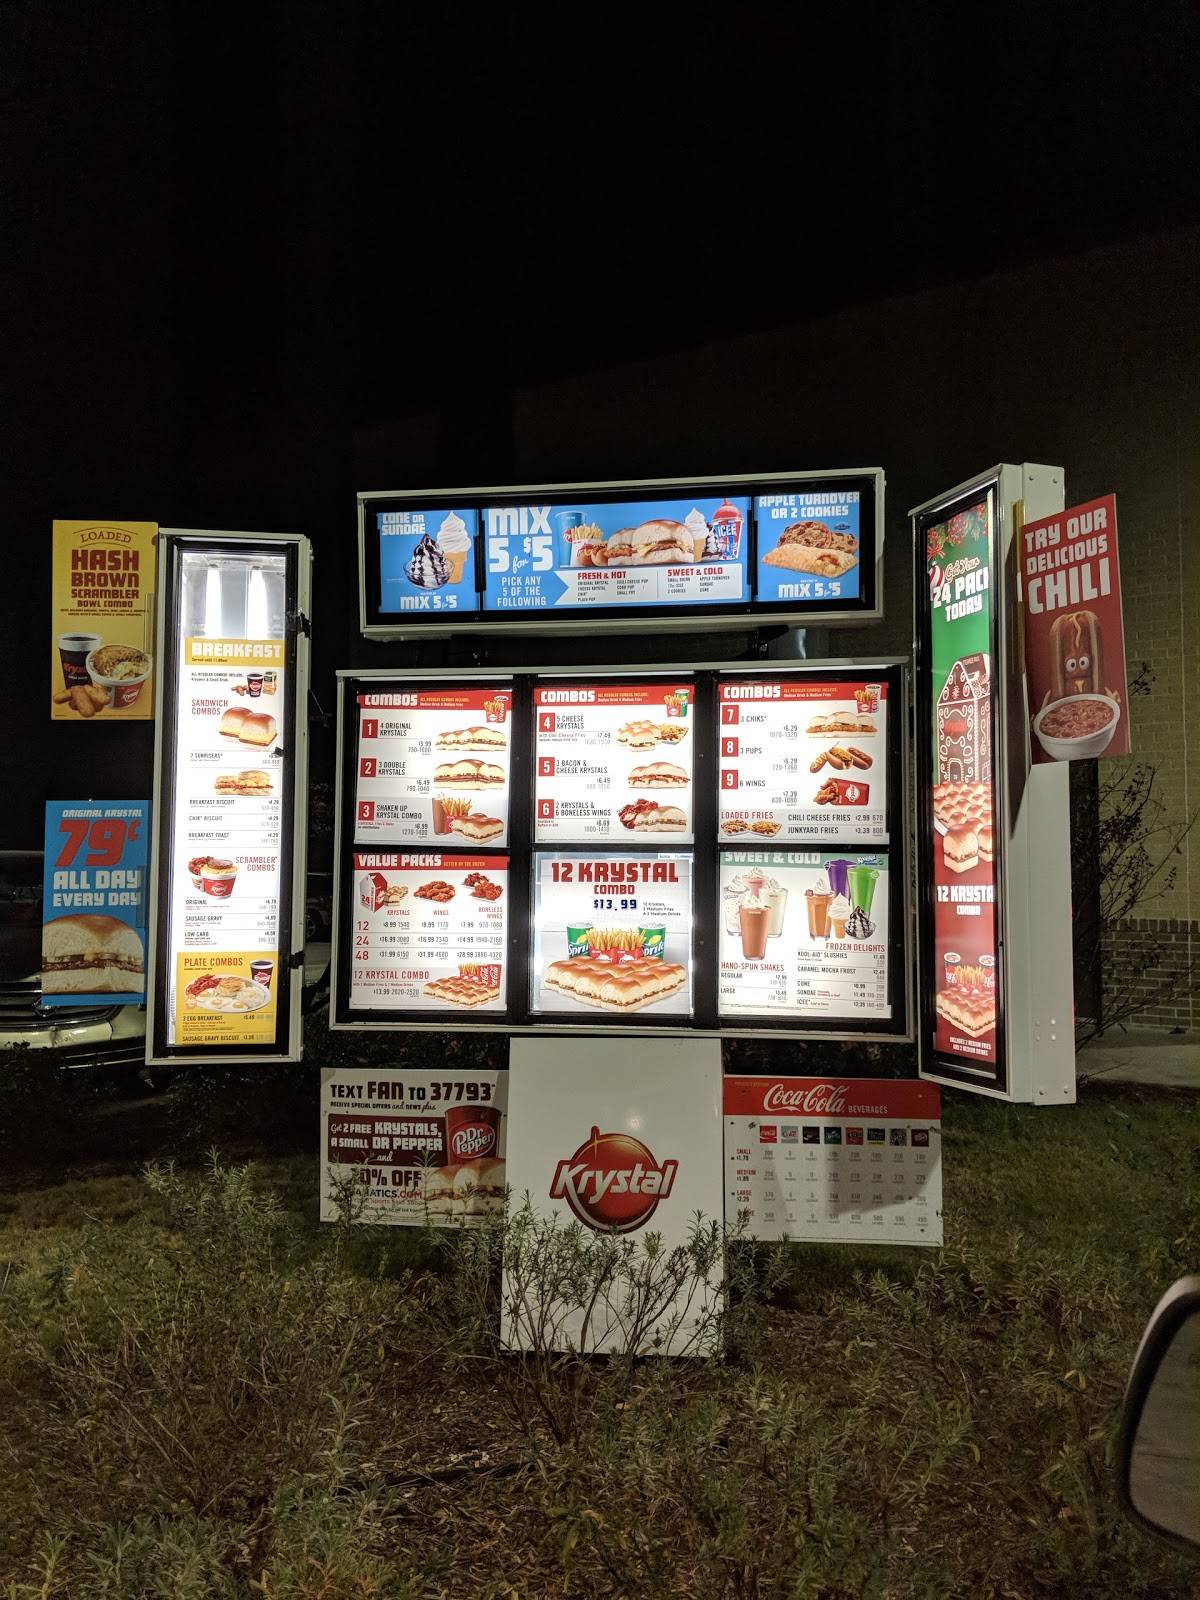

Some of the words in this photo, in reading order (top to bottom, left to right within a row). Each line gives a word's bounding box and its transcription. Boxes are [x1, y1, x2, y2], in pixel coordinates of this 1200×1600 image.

[759, 496, 795, 507] APPLE
[799, 492, 859, 505] TURNOVER
[382, 512, 411, 523] CONE
[413, 514, 424, 523] OR
[771, 508, 787, 518] OR
[792, 508, 797, 517] 2
[801, 506, 848, 517] COOKIES
[489, 507, 552, 535] MIX
[382, 524, 425, 535] SUNDAE
[718, 525, 736, 536] ICEE
[1024, 523, 1061, 553] TRY
[1067, 507, 1107, 539] OUR
[81, 531, 131, 544] LOADED
[72, 550, 139, 571] HASH
[489, 538, 509, 572] 5
[512, 556, 528, 574] for
[523, 536, 553, 571] $5
[1026, 534, 1108, 576] DELICIOUS
[72, 572, 139, 588] BROWN
[502, 577, 521, 586] PICK
[525, 576, 541, 585] ANY
[1028, 557, 1111, 615] CHILI
[71, 589, 139, 599] SCRAMBLER
[503, 588, 507, 596] 5
[511, 587, 522, 595] OF
[525, 586, 540, 595] THE
[779, 584, 810, 598] MIX
[933, 583, 951, 608] 24
[77, 600, 101, 608] BOWL
[104, 600, 133, 608] COMBO
[400, 596, 429, 609] MIX
[497, 597, 546, 607] FOLLOWING
[945, 594, 982, 622] TODAY
[192, 642, 281, 657] BREAKFAST
[541, 690, 595, 702] COMBOS
[724, 686, 780, 698] COMBOS
[365, 694, 418, 706] COMBOS
[727, 709, 733, 721] 7
[544, 717, 550, 728] 4
[727, 741, 734, 753] 8
[365, 762, 372, 774] 2
[544, 761, 550, 773] 5
[726, 773, 733, 786] 9
[104, 809, 142, 817] KRYSTAL
[363, 805, 370, 817] 3
[543, 803, 549, 815] 6
[55, 819, 140, 867] 79¢
[359, 855, 397, 866] VALUE
[401, 855, 441, 866] PACKS
[725, 853, 770, 863] SWEET
[788, 853, 821, 864] COLD
[552, 863, 573, 882] 12
[578, 863, 678, 882] KRYSTAL
[54, 871, 91, 889] ALL
[95, 870, 140, 889] DAY
[594, 885, 635, 895] COMBO
[937, 886, 949, 902] 12
[53, 893, 105, 906] EVERY
[108, 892, 141, 906] DAY
[594, 899, 637, 911] $13.99
[357, 921, 369, 930] 12
[356, 936, 369, 945] 24
[826, 943, 851, 951] FROZEN
[853, 944, 885, 952] DELIGHTS
[184, 958, 207, 966] PLATE
[210, 957, 243, 966] COMBOS
[355, 951, 369, 960] 48
[721, 962, 758, 970] HAND-SPUN
[760, 963, 784, 971] SHAKES
[354, 971, 362, 979] 12
[366, 971, 398, 979] KRYSTAL
[402, 971, 429, 979] COMBO
[330, 1084, 363, 1099] TEXT
[368, 1081, 403, 1100] FAN
[409, 1087, 426, 1100] TO
[392, 1102, 404, 1110] and
[422, 1103, 436, 1113] plus
[849, 1105, 888, 1114] BEVERAGES
[350, 1124, 372, 1133] FREE
[375, 1122, 442, 1137] KRYSTALS,
[466, 1127, 483, 1141] Dr
[331, 1138, 338, 1147] A
[339, 1138, 369, 1148] SMALL
[373, 1137, 390, 1149] DR
[392, 1137, 442, 1151] PEPPER
[455, 1131, 493, 1155] Pepper
[377, 1152, 393, 1162] and
[553, 1162, 677, 1204] Krystal
